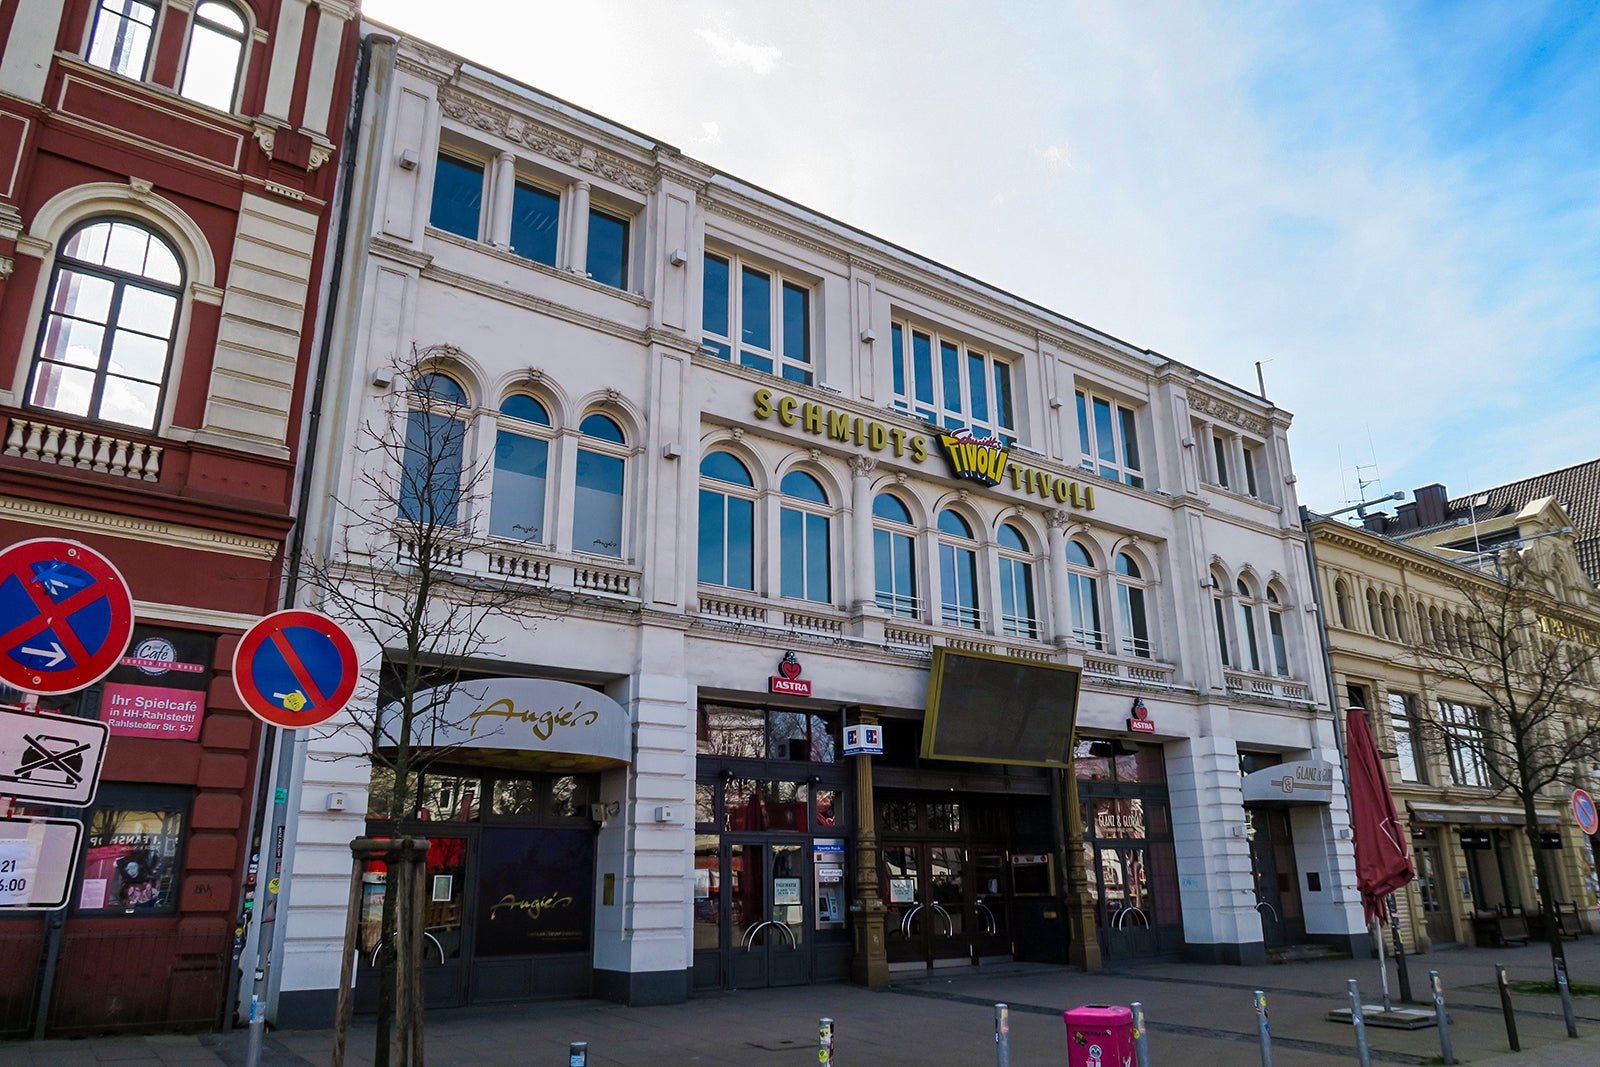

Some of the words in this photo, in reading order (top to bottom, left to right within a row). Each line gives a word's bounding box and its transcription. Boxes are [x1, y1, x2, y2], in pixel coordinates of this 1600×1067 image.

[754, 388, 928, 463] SCHMIDTS
[940, 434, 1009, 483] TIVOLI
[1008, 463, 1095, 510] TIVOLI
[140, 644, 169, 665] Café
[775, 680, 808, 692] ASTRA
[111, 694, 131, 706] Ihr
[134, 696, 198, 712] Spielcafé
[109, 708, 120, 716] in
[122, 709, 195, 722] HH-Rahlstedt!
[108, 719, 160, 730] Rahlstedter
[162, 723, 177, 731] Str.
[180, 724, 193, 732] 5-7
[1133, 721, 1153, 730] ASTRA
[1296, 765, 1317, 781] GLANZ
[1, 859, 17, 873] 21
